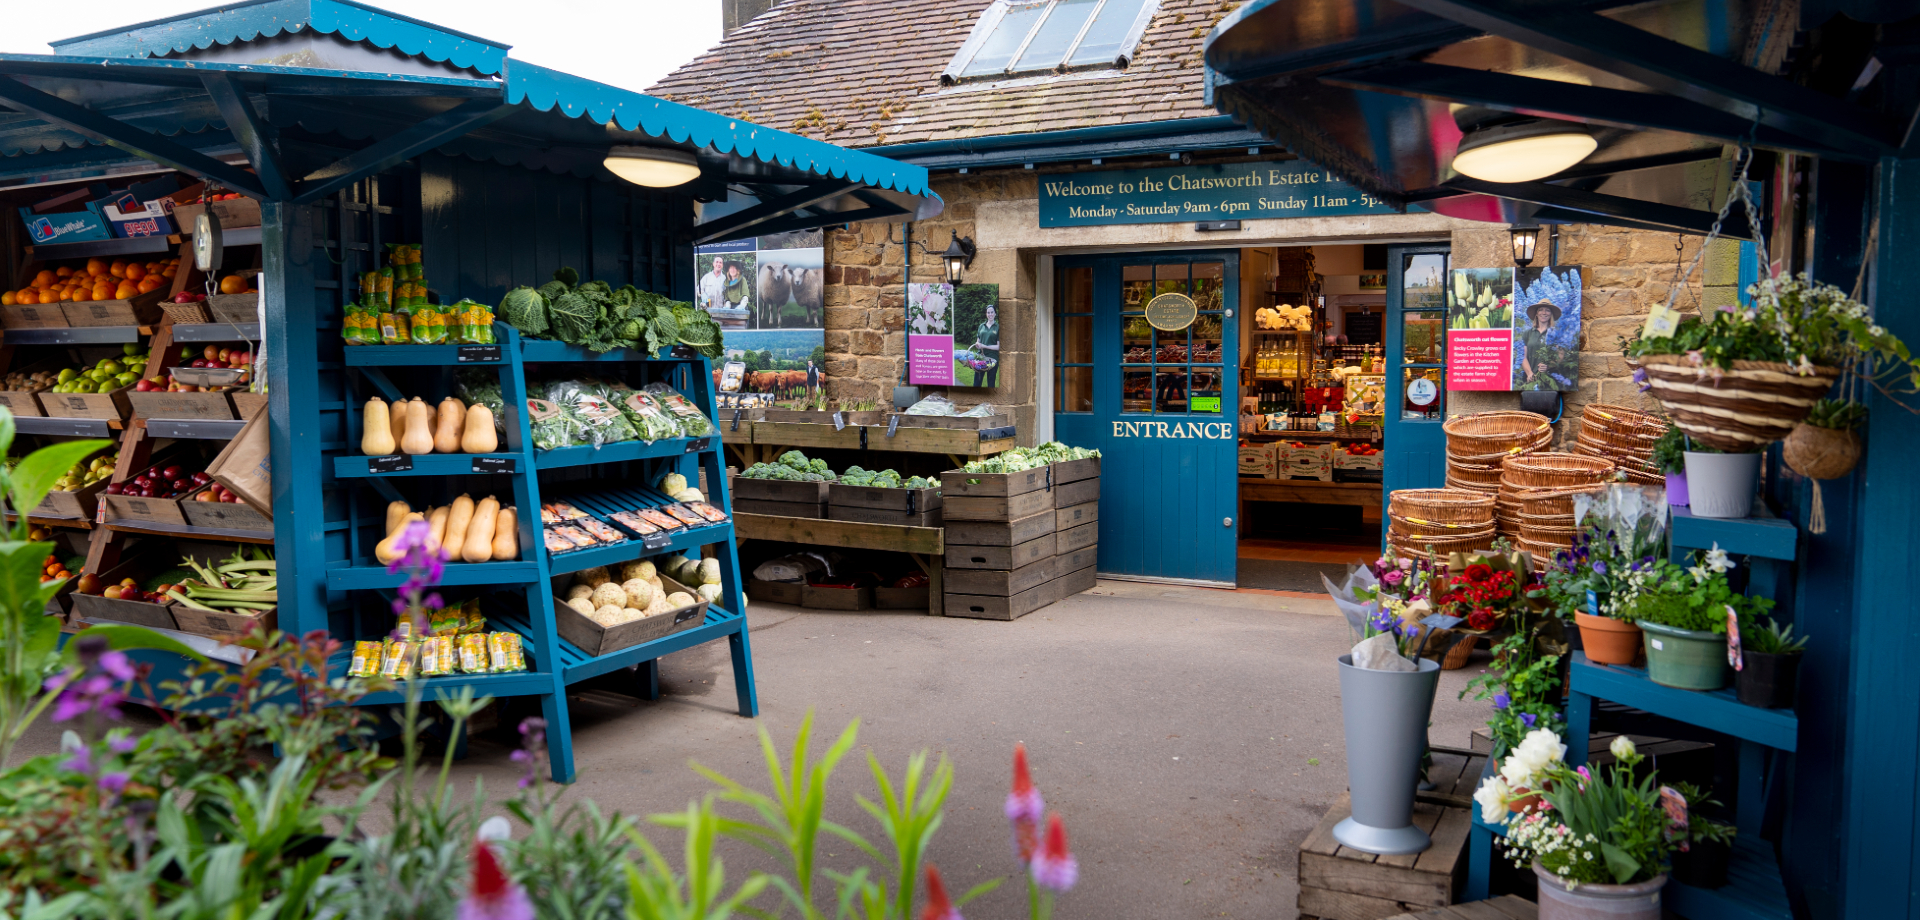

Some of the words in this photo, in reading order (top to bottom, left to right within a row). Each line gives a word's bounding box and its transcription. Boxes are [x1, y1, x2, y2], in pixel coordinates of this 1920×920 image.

[1045, 181, 1114, 197] Welcome
[1119, 182, 1134, 194] to
[1139, 176, 1164, 193] the
[1168, 170, 1263, 191] Chatsworth
[1268, 169, 1319, 186] Estate
[1069, 205, 1118, 219] Monday
[1126, 202, 1181, 216] Saturday
[1183, 201, 1211, 213] 9am
[1220, 200, 1250, 214] 6pm
[1258, 196, 1308, 210] Sunday
[1313, 195, 1348, 208] 11am
[1360, 194, 1384, 208] 5p
[124, 218, 159, 237] gregal
[1112, 421, 1232, 440] ENTRANCE
